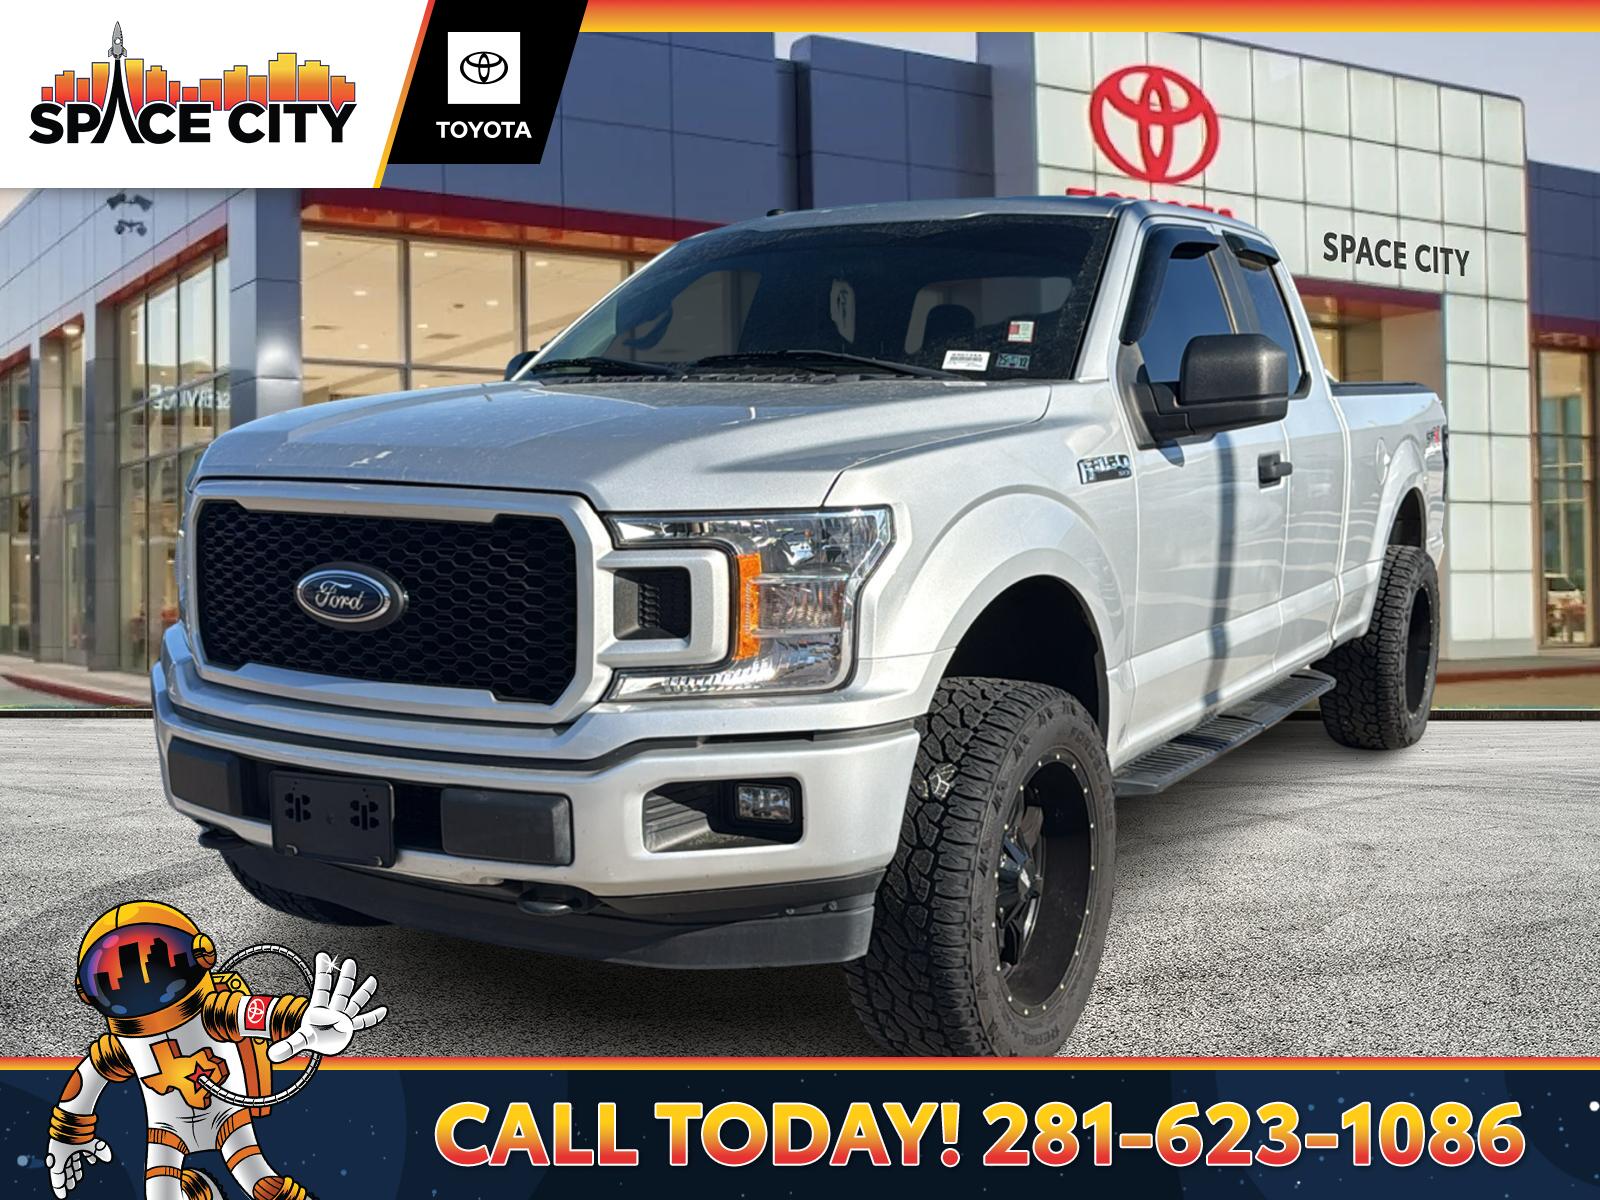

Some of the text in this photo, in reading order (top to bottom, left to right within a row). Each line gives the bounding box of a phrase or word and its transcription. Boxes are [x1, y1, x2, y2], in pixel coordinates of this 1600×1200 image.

[1323, 232, 1471, 277] SPACE CITY
[315, 580, 365, 611] Ford
